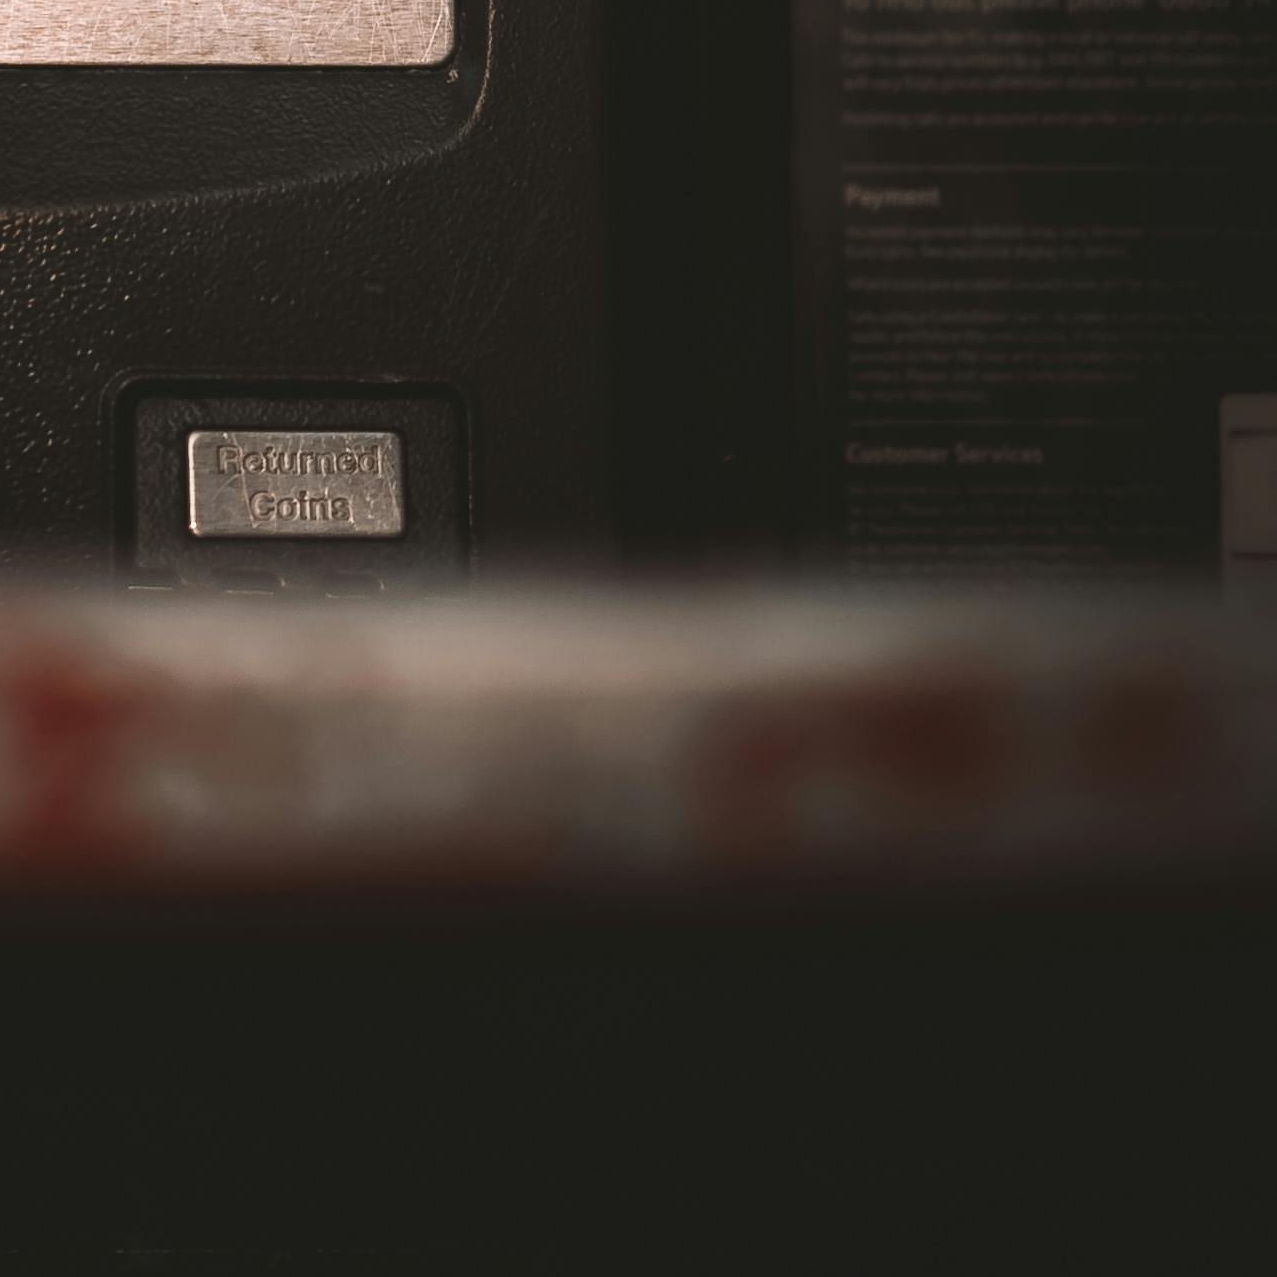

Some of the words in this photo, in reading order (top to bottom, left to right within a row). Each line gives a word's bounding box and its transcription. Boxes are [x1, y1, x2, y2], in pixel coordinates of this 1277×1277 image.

[843, 182, 941, 211] Payment
[216, 445, 382, 476] Returned
[845, 440, 949, 465] Customer
[955, 440, 1045, 465] Services
[249, 490, 353, 522] Coins
